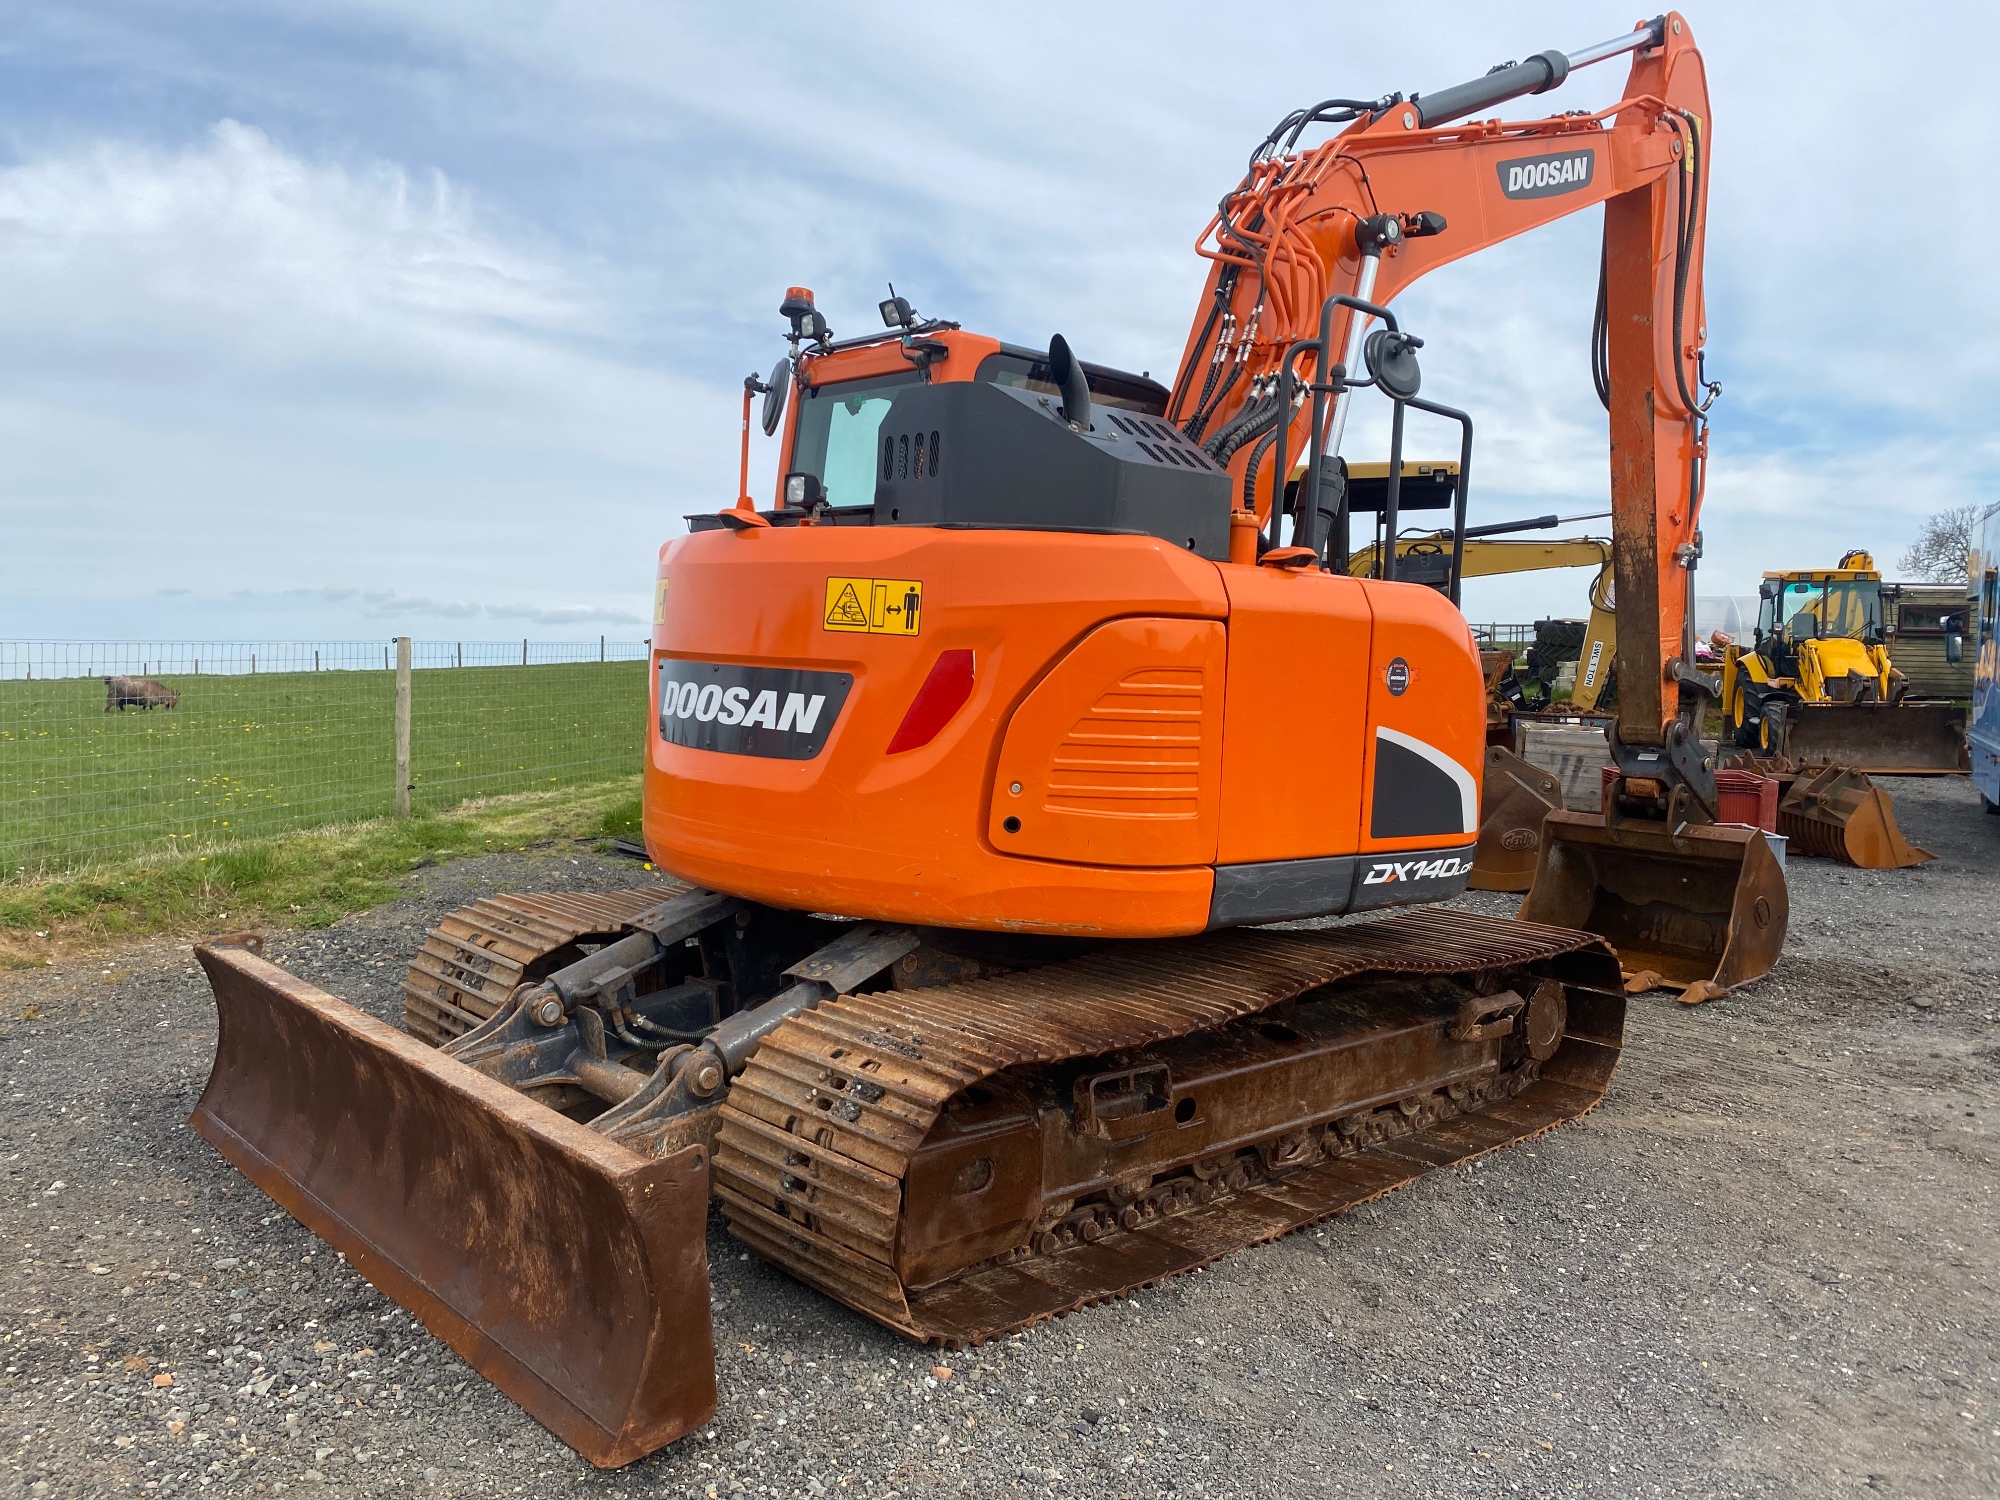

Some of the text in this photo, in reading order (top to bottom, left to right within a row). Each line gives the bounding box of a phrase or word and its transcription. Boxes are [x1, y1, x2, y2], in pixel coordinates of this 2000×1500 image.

[1508, 156, 1588, 192] DOOSAN
[1591, 642, 1602, 660] SWL
[1585, 669, 1596, 686] TON
[662, 680, 827, 734] DOOSAN
